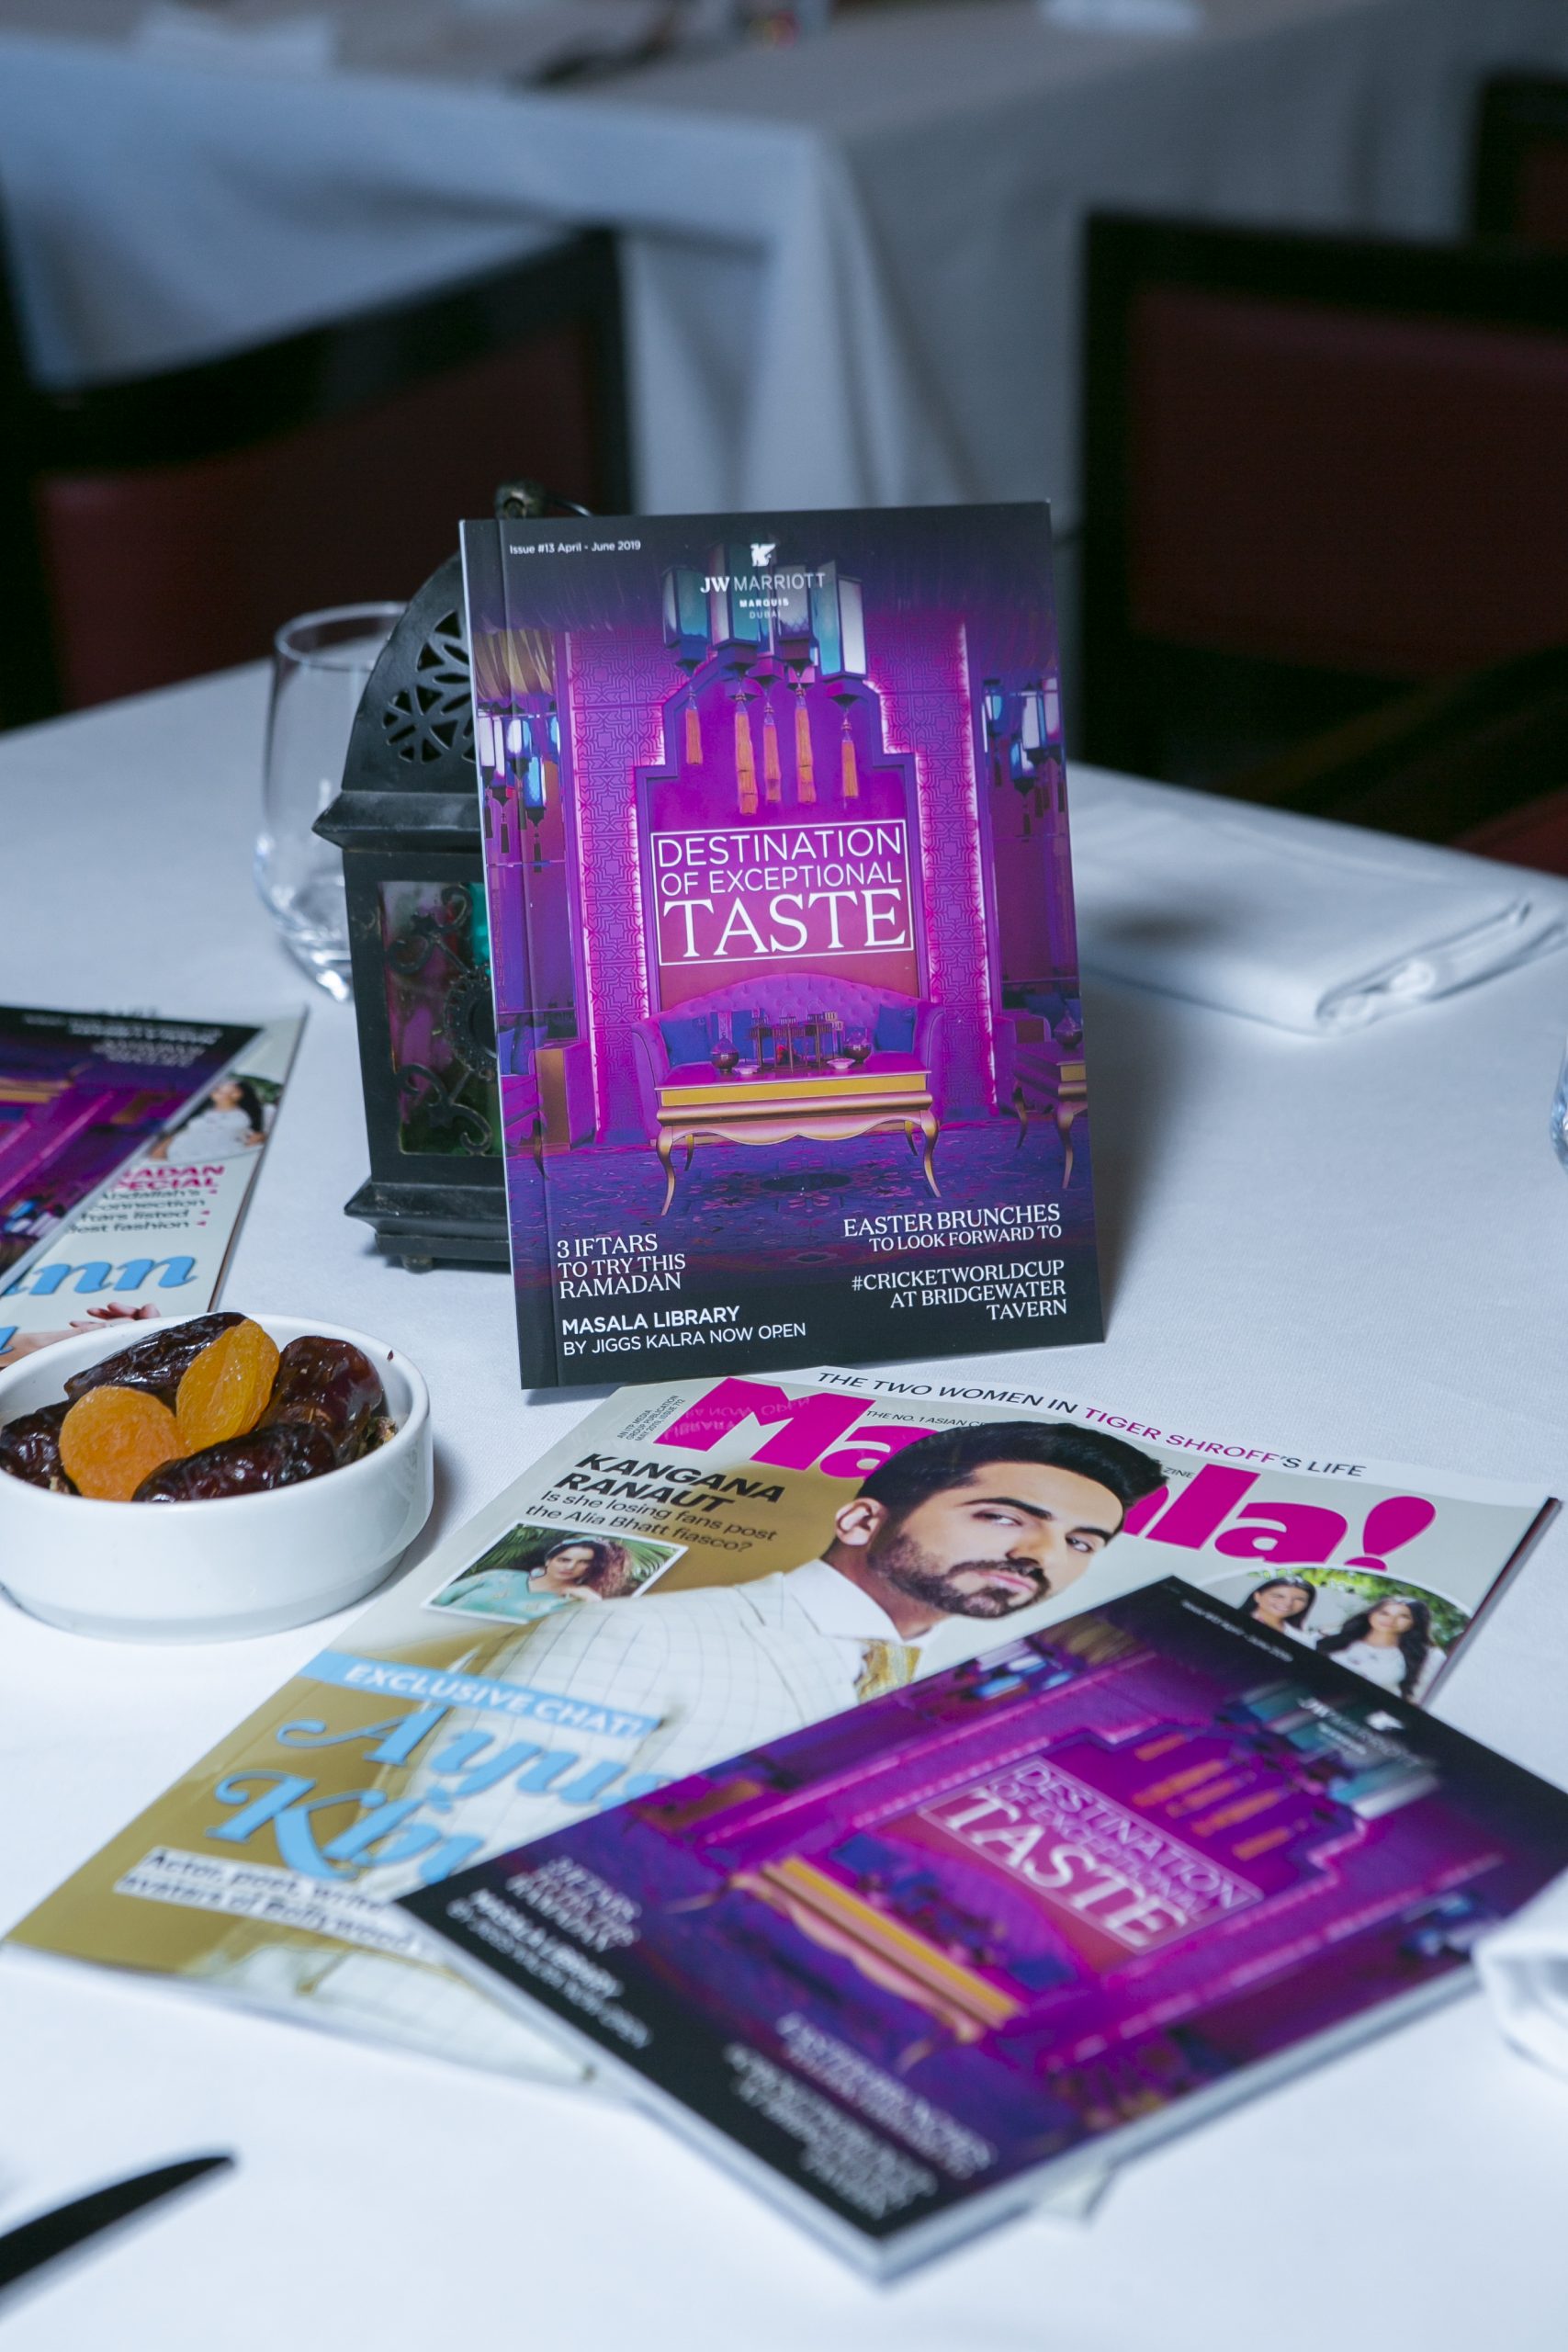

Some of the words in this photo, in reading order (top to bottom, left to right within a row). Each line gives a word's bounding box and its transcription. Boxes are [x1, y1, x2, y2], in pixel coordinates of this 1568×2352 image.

[509, 544, 536, 555] Issue
[537, 542, 555, 553] #13
[557, 542, 582, 554] April
[591, 541, 615, 552] June
[617, 539, 641, 551] 2019
[700, 576, 730, 594] JW
[734, 572, 826, 592] MARRIOTT
[739, 597, 789, 608] MARQUIS
[658, 827, 902, 867] DESTINATION
[660, 872, 699, 897] OF
[709, 861, 902, 894] EXCEPTIONAL
[663, 888, 906, 958] TASTE
[123, 1165, 225, 1178] ADAN
[843, 1213, 934, 1238] EASTER
[937, 1203, 1060, 1230] BRUNCHES
[557, 1240, 570, 1259] 3
[575, 1233, 658, 1258] IFTARS
[868, 1238, 895, 1252] TO
[897, 1233, 945, 1250] LOOK
[949, 1227, 1034, 1247] FORWARD
[1036, 1224, 1062, 1239] TO
[1, 1256, 197, 1296] nn
[558, 1261, 588, 1279] TO
[592, 1257, 634, 1276] TRY
[637, 1253, 686, 1272] THIS
[852, 1259, 1065, 1292] #CRICKETWORLDCUP
[558, 1272, 682, 1299] RAMADAN
[890, 1291, 917, 1309] AT
[921, 1280, 1066, 1306] BRIDGEWATER
[561, 1313, 649, 1336] MASALA
[653, 1306, 740, 1329] LIBRARY
[986, 1298, 1067, 1320] TAVERN
[563, 1340, 587, 1356] BY
[592, 1336, 642, 1354] JIGGS
[646, 1331, 706, 1350] KALRA
[709, 1327, 754, 1344] NOW
[758, 1322, 807, 1340] OPEN
[633, 1409, 652, 1424] MEDIA
[643, 1395, 679, 1424] PUBLICATION
[817, 1373, 867, 1388] THE
[873, 1380, 932, 1396] TWO
[939, 1386, 1049, 1407] WOMEN
[1048, 1399, 1078, 1415] IN
[1084, 1408, 1162, 1441] TIGER
[1166, 1434, 1303, 1468] SHROFF'S
[1307, 1460, 1368, 1477] LIFE
[866, 1410, 891, 1419] THE
[892, 1414, 915, 1422] NO.
[925, 1417, 967, 1426] ASIAN
[553, 1472, 736, 1513] RANAUT
[574, 1453, 785, 1503] KANGANA
[525, 1505, 561, 1520] the
[568, 1509, 604, 1525] Alia
[609, 1518, 671, 1536] Bhatt
[671, 1527, 753, 1553] fiasco?
[540, 1490, 558, 1502] Is
[562, 1494, 604, 1510] she
[606, 1498, 673, 1521] losing
[674, 1510, 723, 1531] fans
[724, 1524, 778, 1542] post
[344, 1664, 536, 1713] EXCLUSIVE
[532, 1696, 644, 1738] CHAT!
[943, 1788, 1188, 1946] TASTE
